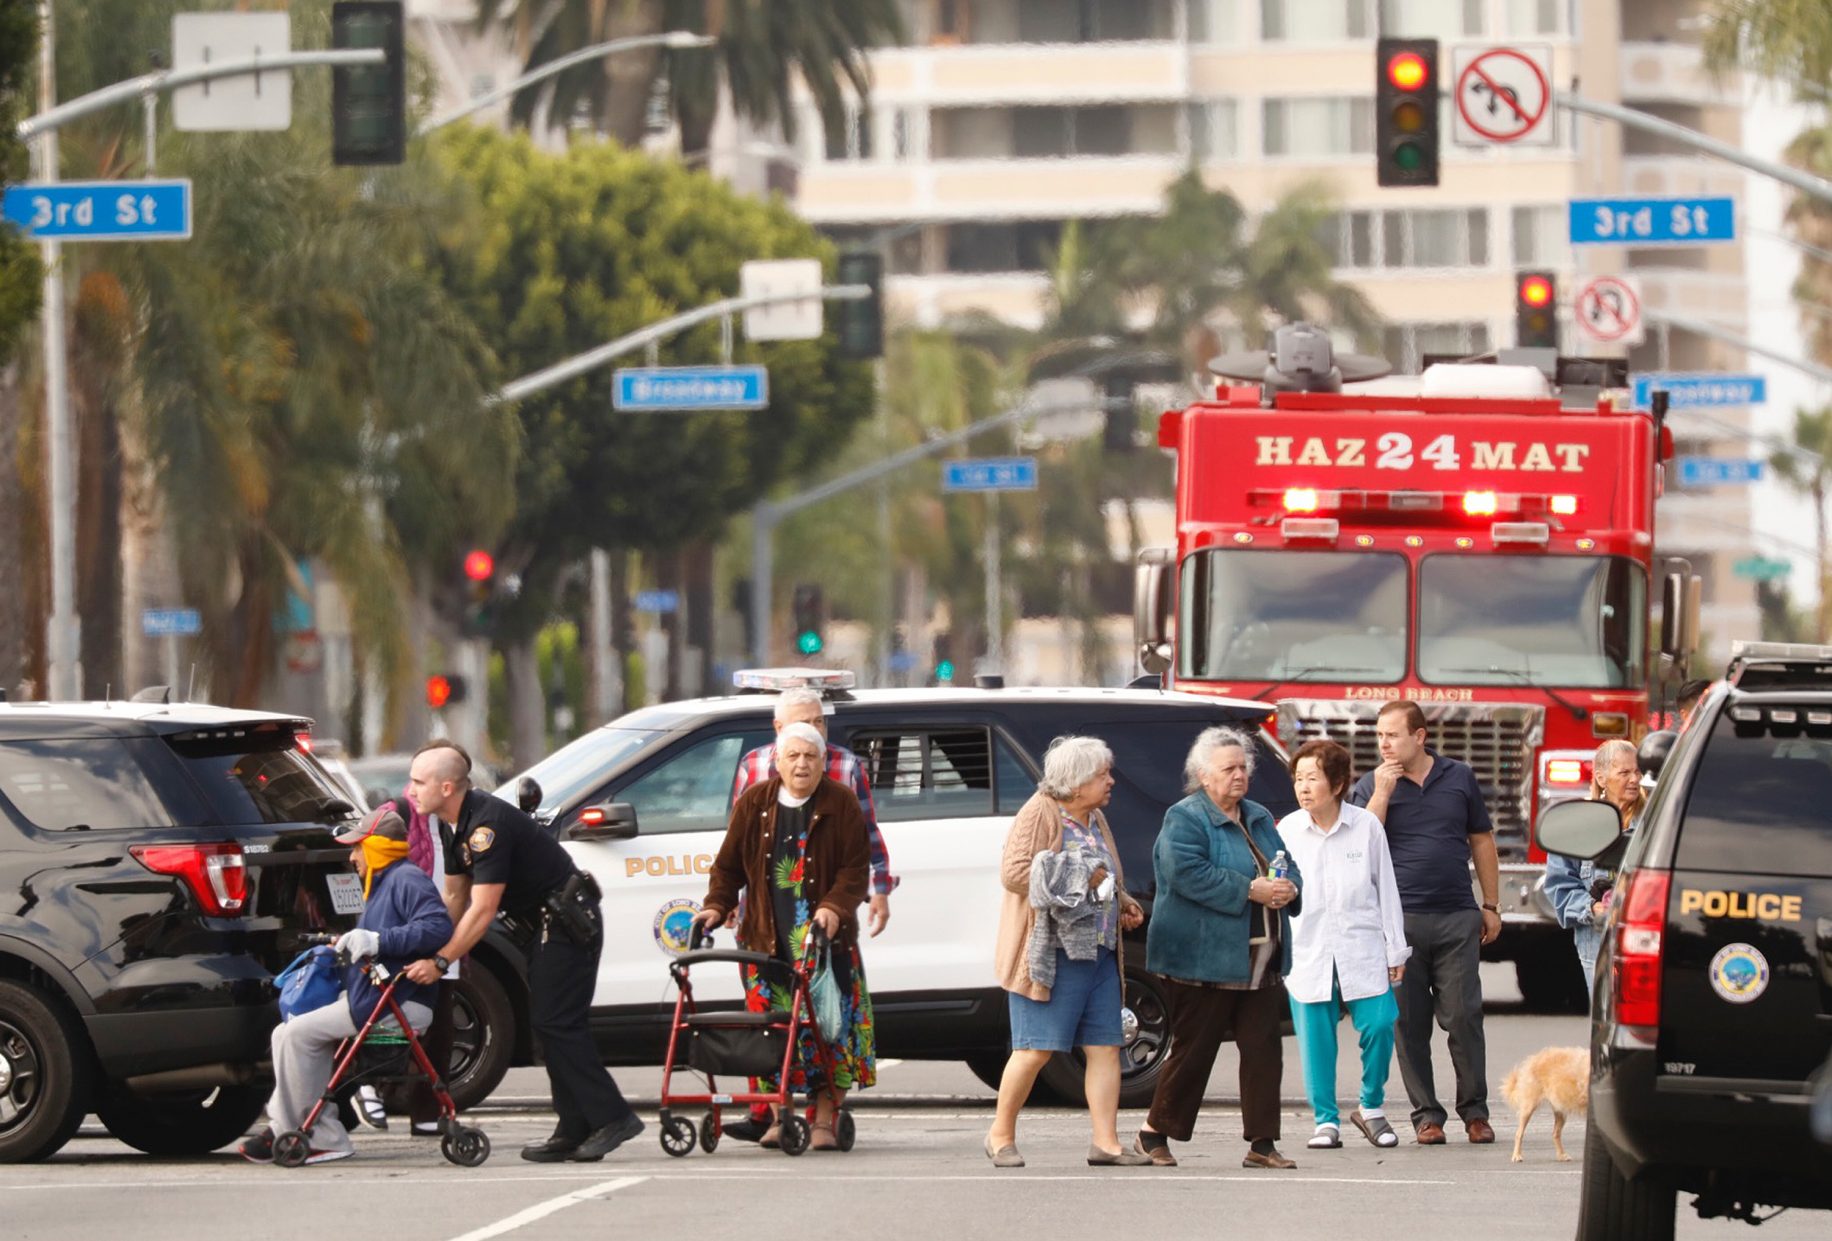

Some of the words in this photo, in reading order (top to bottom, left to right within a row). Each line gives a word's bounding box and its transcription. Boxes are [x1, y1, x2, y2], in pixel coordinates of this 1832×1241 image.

[32, 195, 94, 228] 3rd
[115, 194, 157, 226] St
[1594, 205, 1652, 237] 3rd
[1670, 204, 1709, 236] St
[1255, 436, 1366, 466] HAZ
[1375, 432, 1460, 471] 24
[1470, 440, 1590, 472] MAT
[1344, 686, 1401, 700] LONG
[1404, 687, 1474, 701] BEACH
[624, 854, 717, 878] POLIC
[1680, 889, 1803, 922] POLICE
